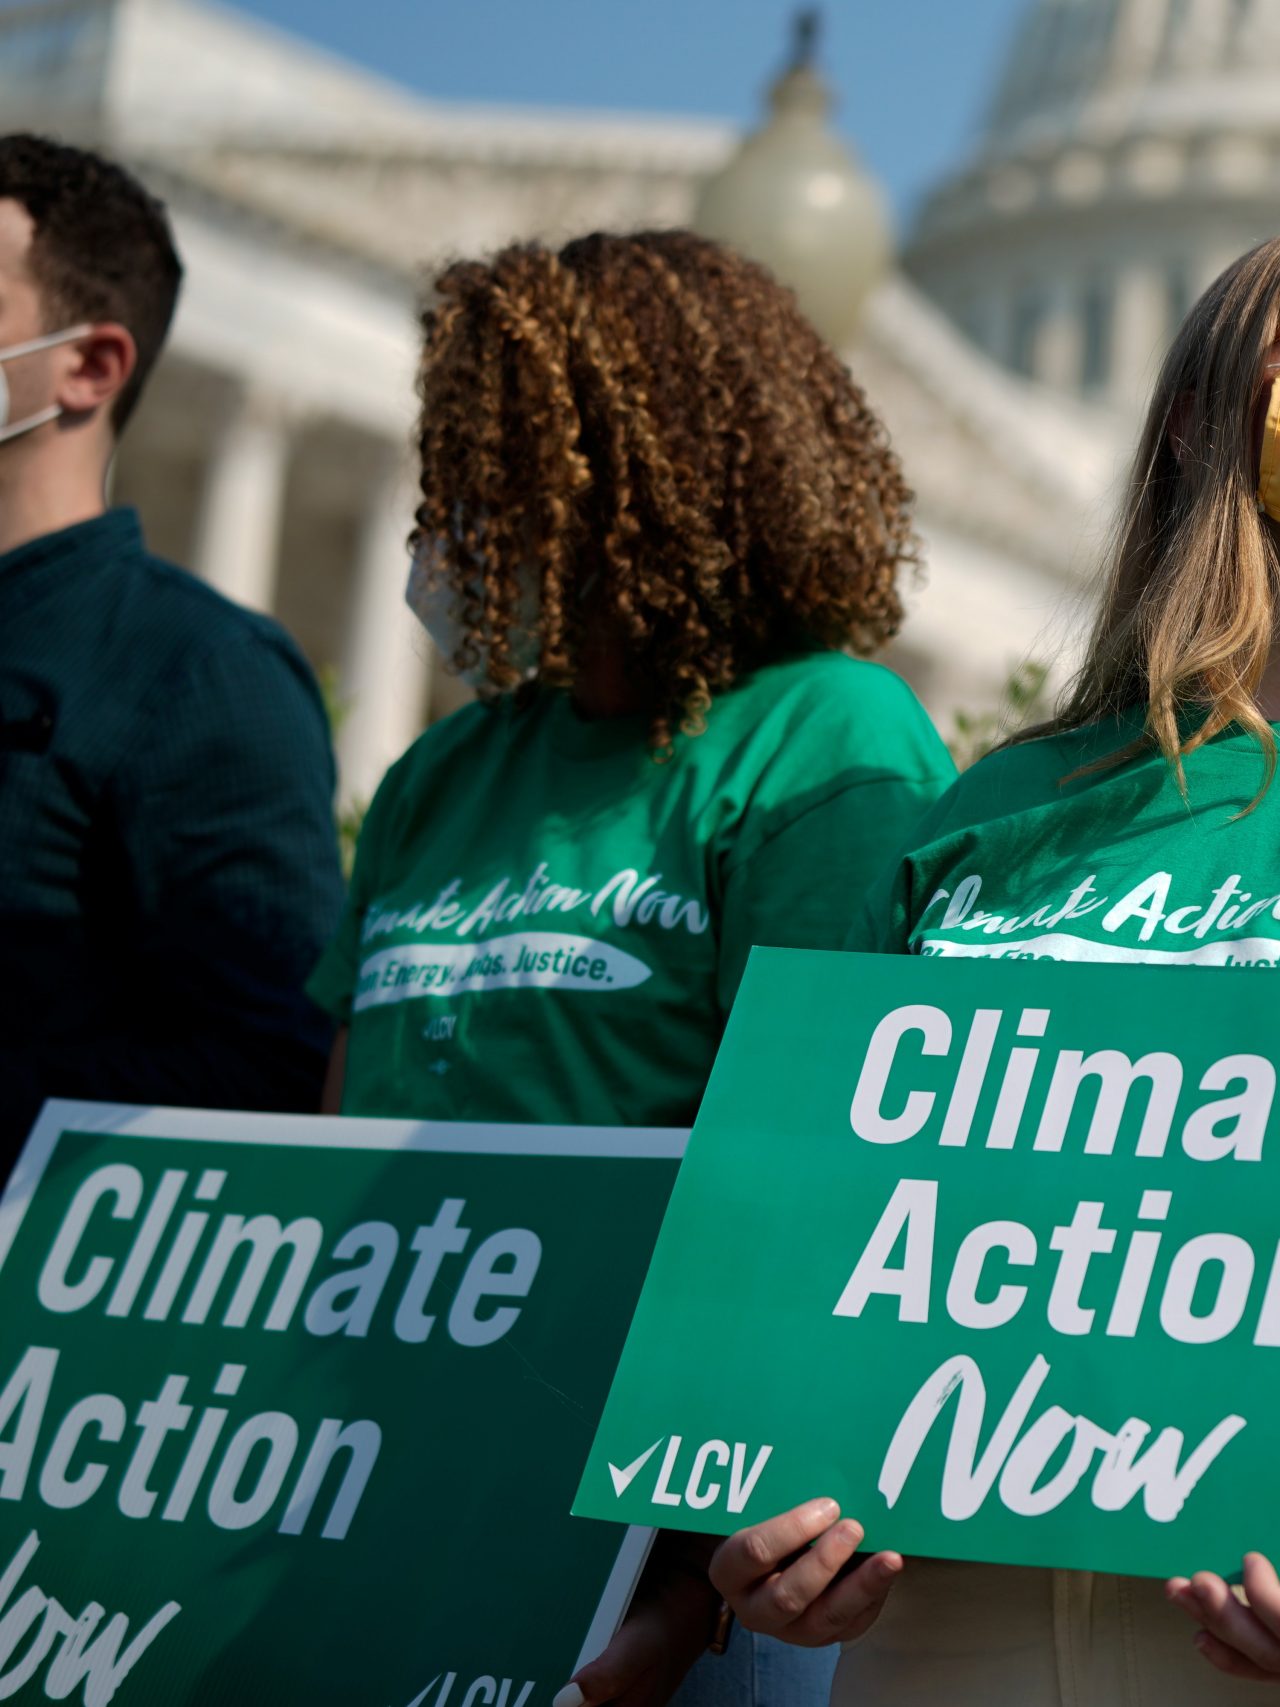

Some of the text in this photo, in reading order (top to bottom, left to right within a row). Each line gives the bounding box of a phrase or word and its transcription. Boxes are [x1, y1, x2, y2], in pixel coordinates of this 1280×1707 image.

[456, 862, 592, 937] Action
[590, 868, 709, 934] Now
[513, 944, 614, 984] Justice.
[37, 1164, 543, 1347] Climate
[0, 1345, 383, 1541] Action
[651, 1435, 773, 1514] LCV
[877, 1352, 1247, 1523] Now
[0, 1529, 182, 1707] ow
